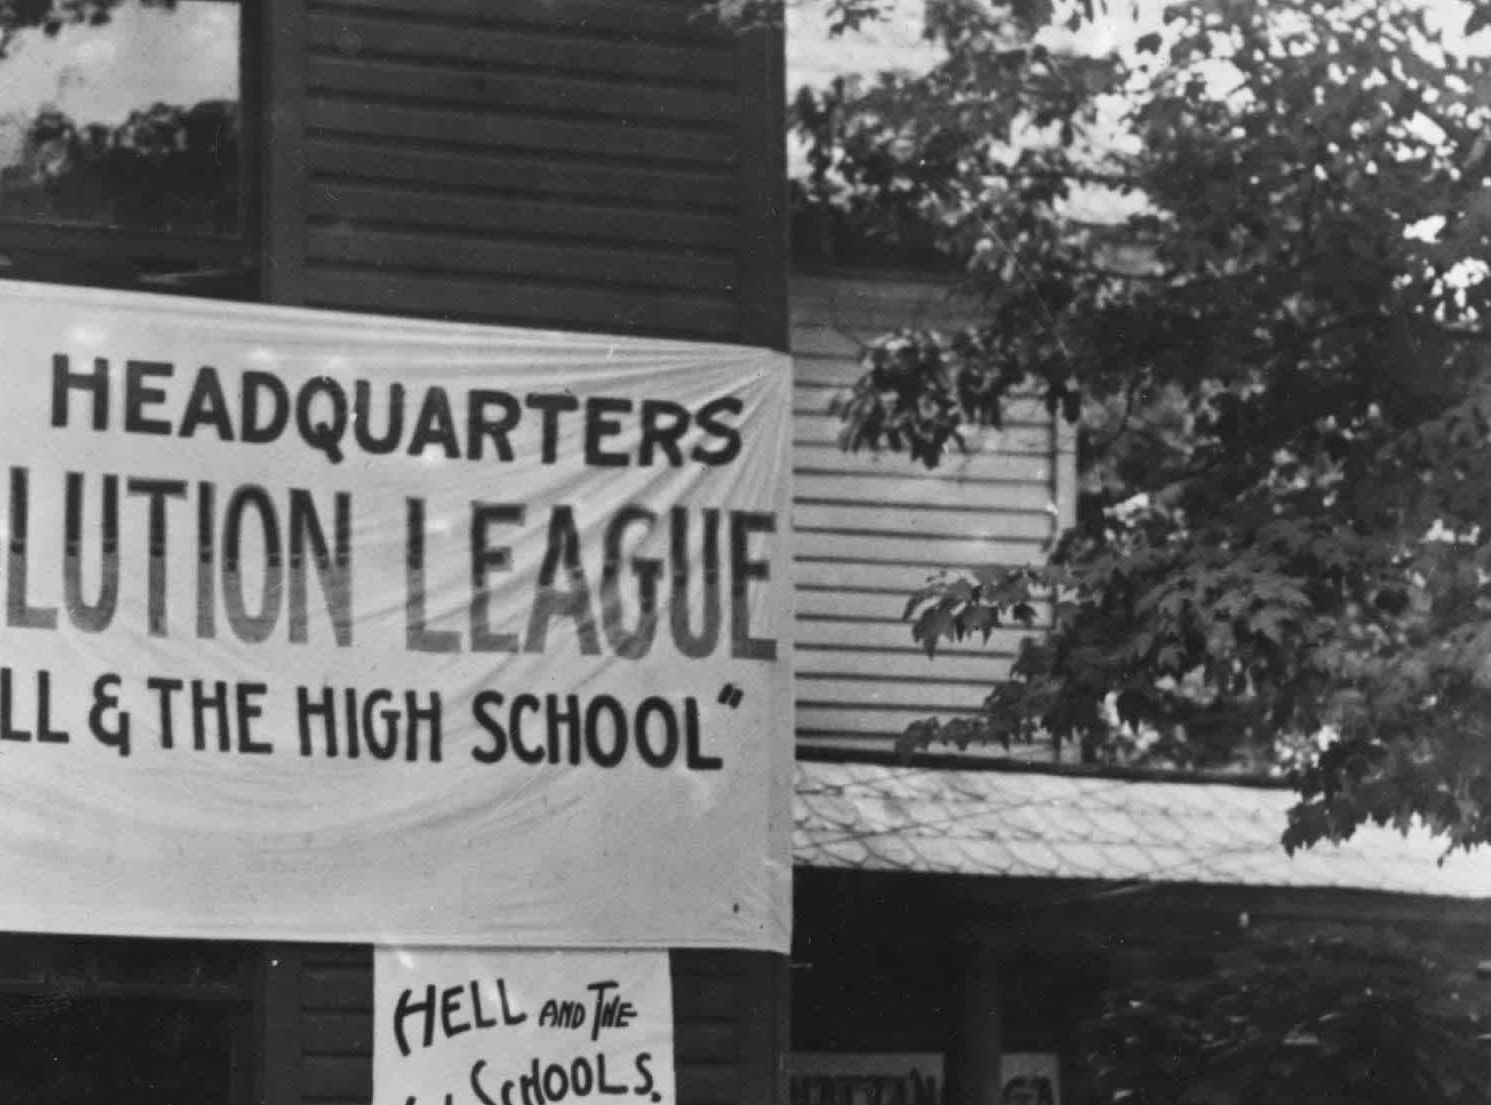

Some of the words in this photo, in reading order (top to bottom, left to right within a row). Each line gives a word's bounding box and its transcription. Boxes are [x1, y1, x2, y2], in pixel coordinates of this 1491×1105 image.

[50, 353, 745, 468] HEADQUARTERS
[405, 496, 777, 662] LEAGUE
[88, 672, 130, 757] &
[147, 676, 273, 755] THE
[296, 685, 443, 762] HIGH
[394, 978, 528, 1057] HELL
[539, 998, 586, 1030] AND
[586, 980, 638, 1042] THE
